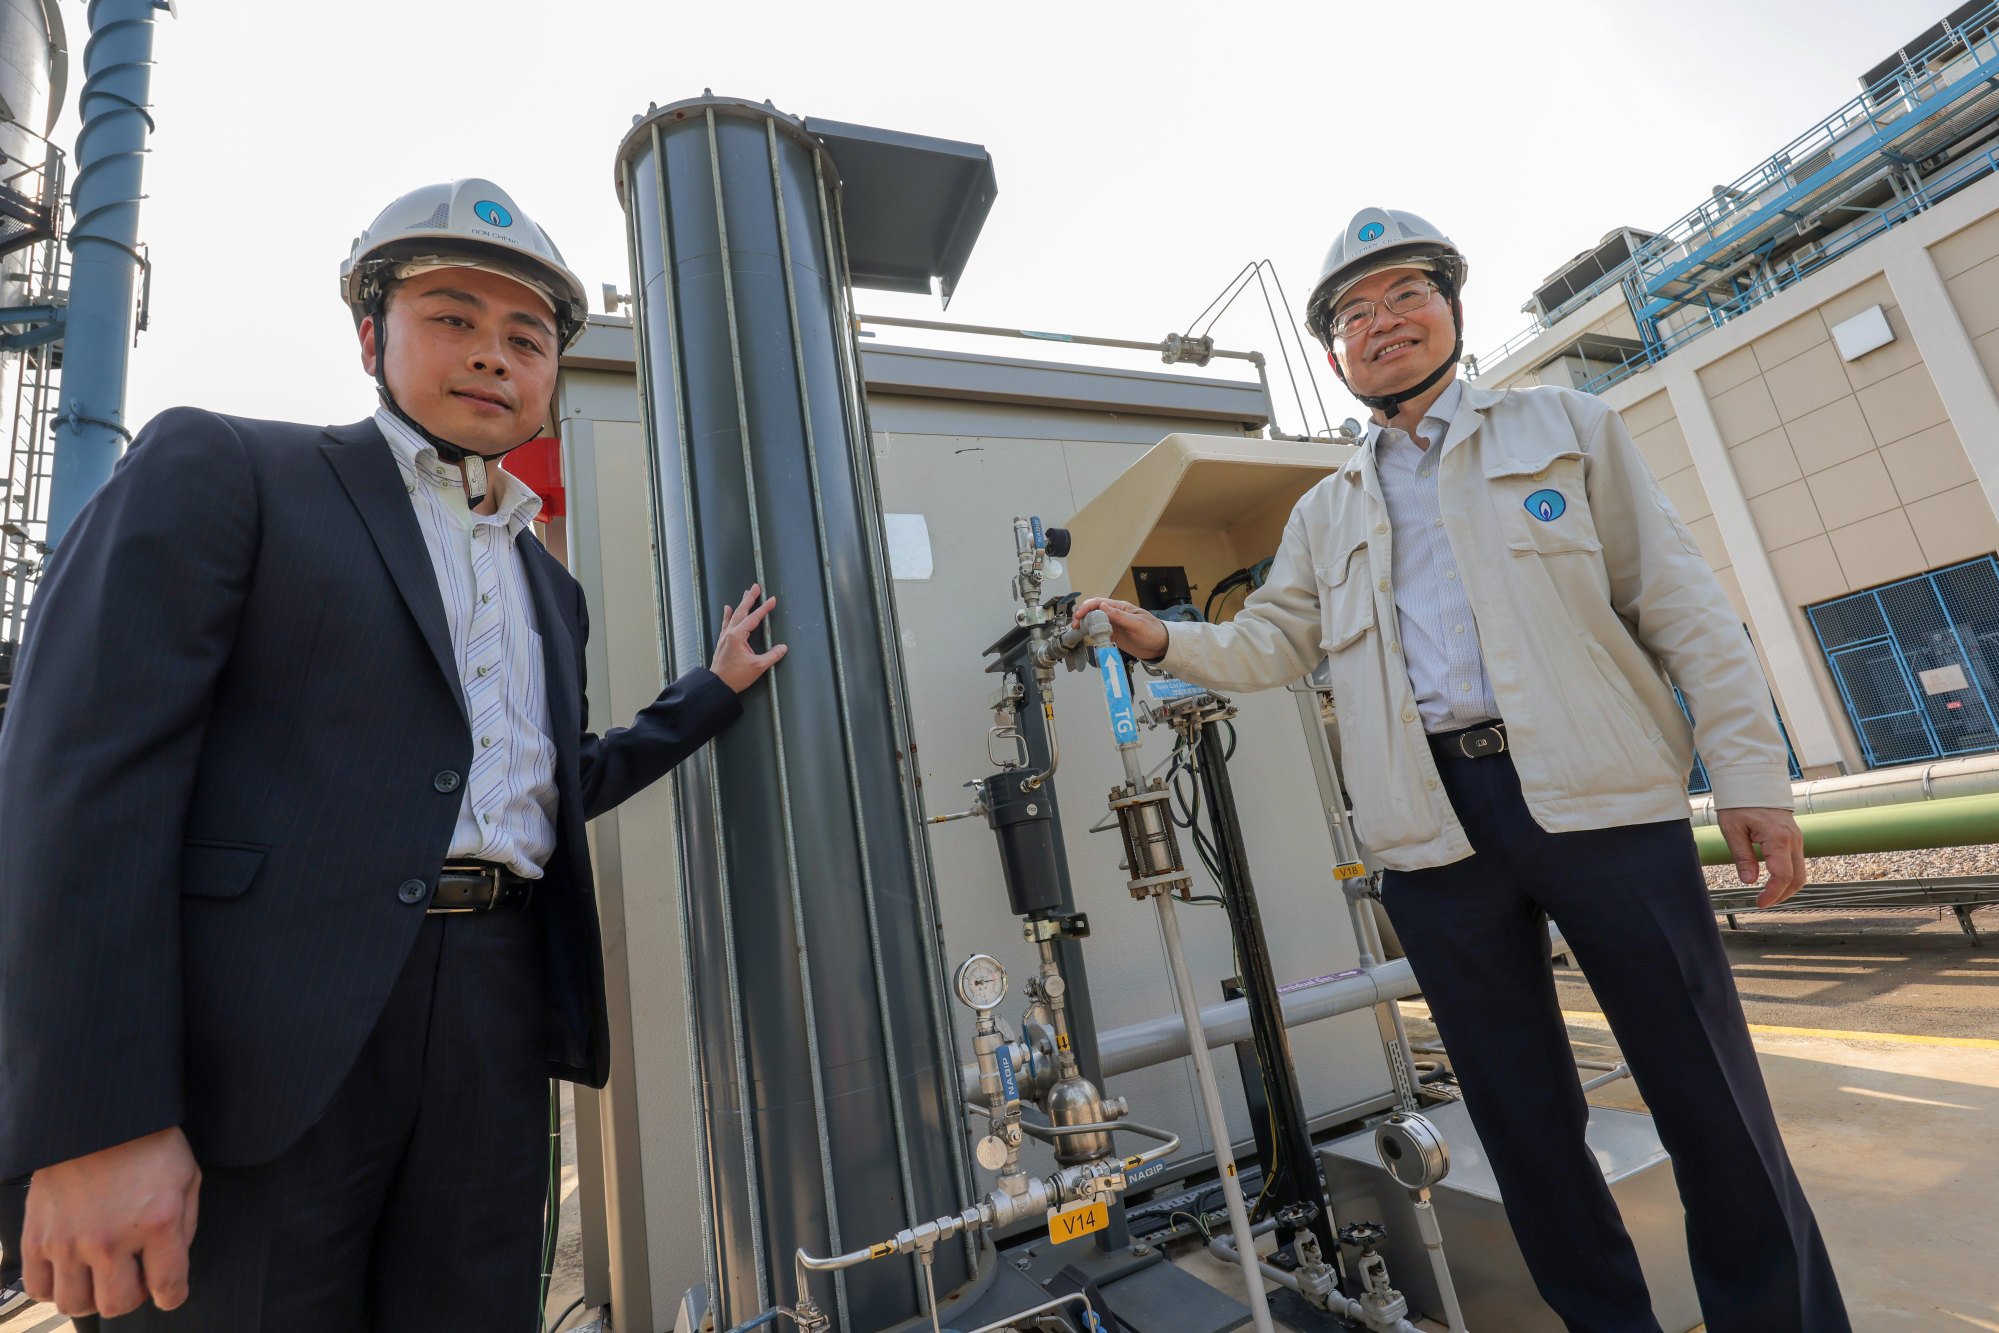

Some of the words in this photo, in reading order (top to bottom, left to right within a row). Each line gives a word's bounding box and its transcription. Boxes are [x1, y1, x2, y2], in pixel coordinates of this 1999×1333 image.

[1114, 707, 1133, 734] TG
[1339, 866, 1359, 877] V18
[1002, 1057, 1015, 1096] NAQIP
[1128, 1163, 1164, 1184] NAQIP
[1062, 1209, 1096, 1235] V14
